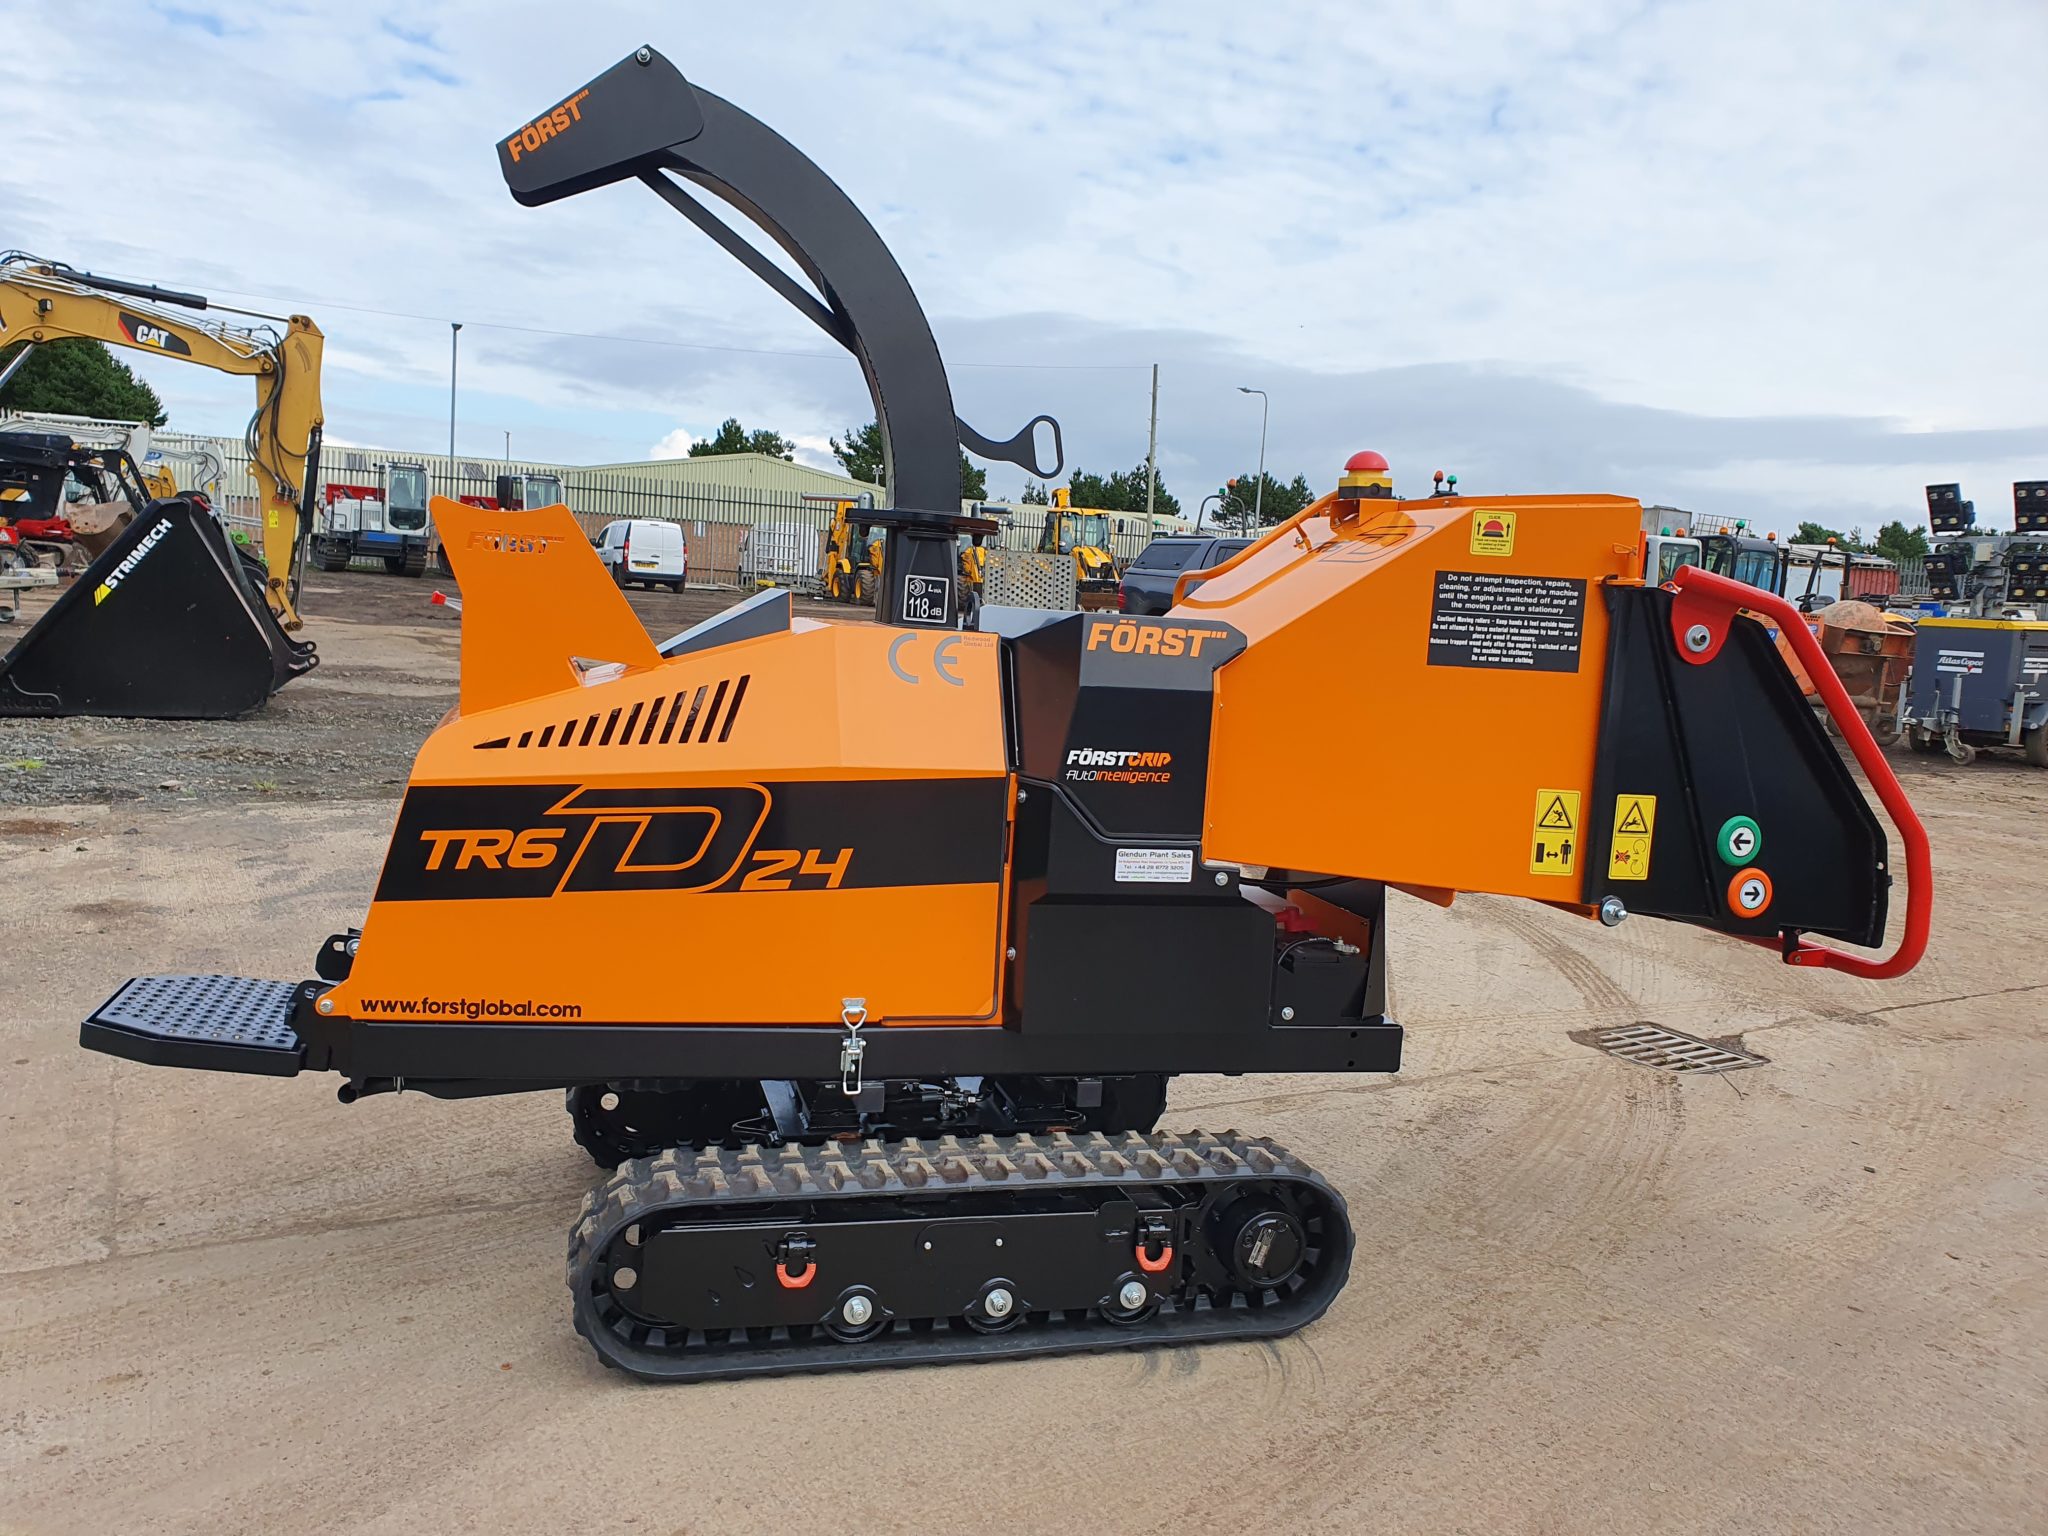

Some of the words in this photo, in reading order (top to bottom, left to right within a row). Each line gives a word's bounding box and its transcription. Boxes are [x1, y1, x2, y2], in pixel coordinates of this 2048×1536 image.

[507, 89, 589, 163] FÖRST
[136, 325, 170, 348] CAT
[104, 518, 173, 589] STRIMECH
[1439, 583, 1470, 592] cleaning,
[1483, 585, 1522, 593] adjustment
[1474, 576, 1502, 584] attempt
[1504, 577, 1543, 586] inspection,
[1545, 580, 1572, 588] repairs,
[908, 597, 929, 618] 118
[930, 607, 942, 616] dB
[1465, 602, 1490, 611] moving
[1528, 606, 1564, 615] stationary
[1471, 594, 1494, 602] engine
[1506, 596, 1538, 604] switched
[1086, 619, 1227, 658] FÖRST
[1938, 656, 1960, 664] Atlas
[1961, 658, 1984, 666] Copco
[740, 848, 854, 891] 24
[361, 997, 582, 1019] www.forstglobal.com
